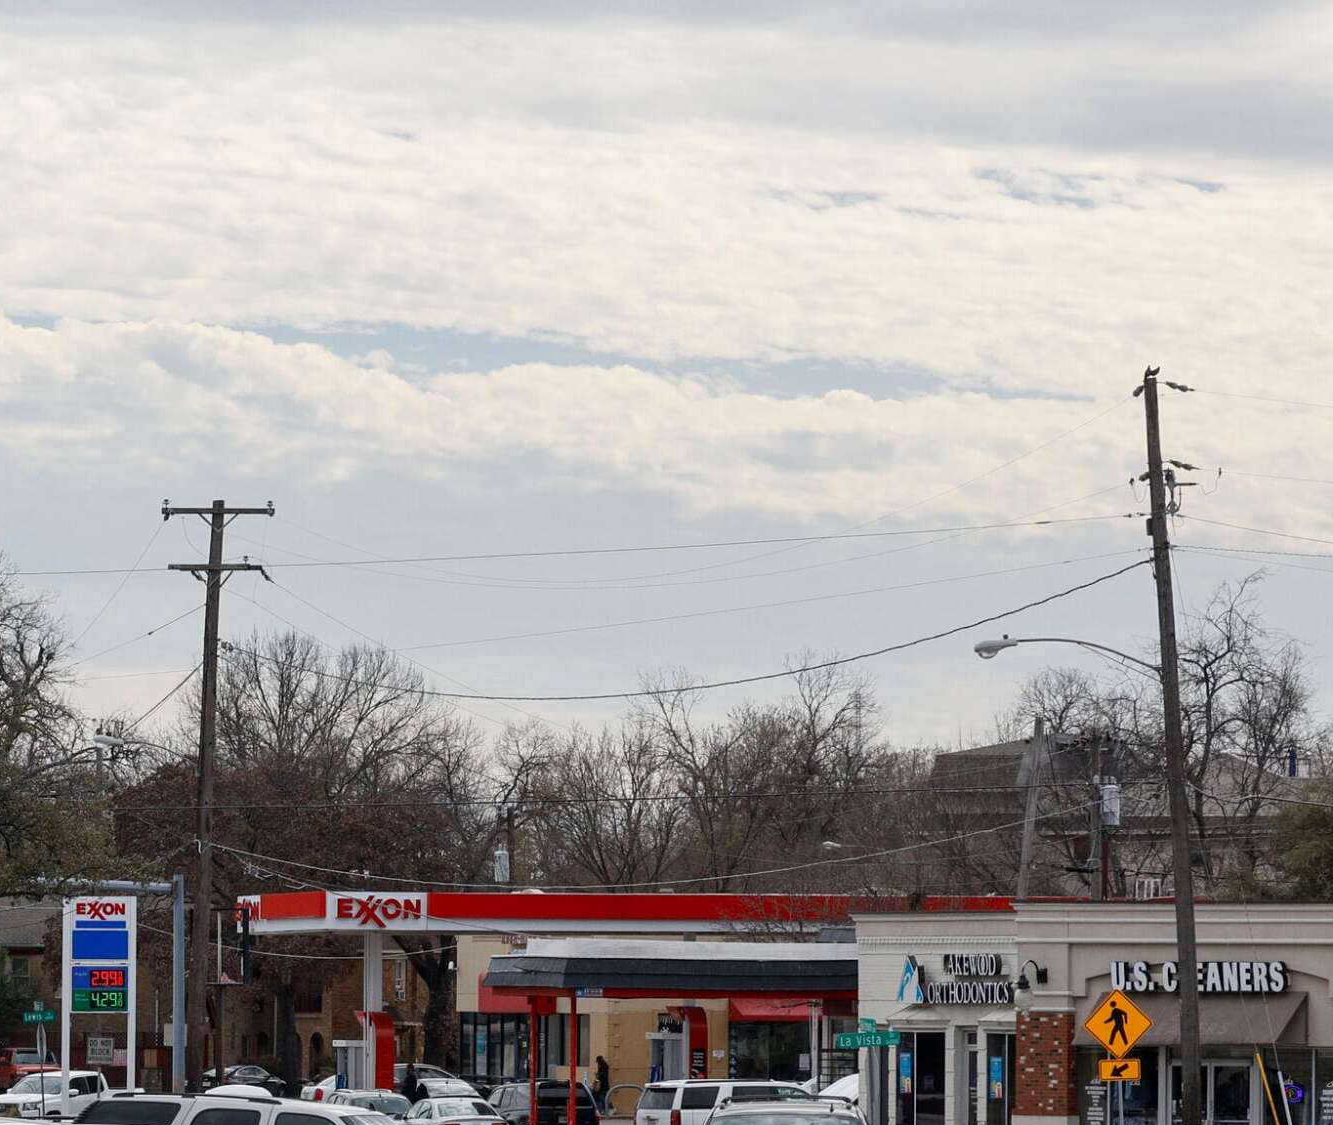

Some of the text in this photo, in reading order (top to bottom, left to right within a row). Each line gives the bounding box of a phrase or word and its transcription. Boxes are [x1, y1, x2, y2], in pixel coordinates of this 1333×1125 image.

[76, 901, 125, 920] EXXON
[337, 895, 422, 929] EXXON
[1110, 961, 1284, 992] U.S. CEANERS
[927, 981, 1010, 1004] ORTHODONTICS
[840, 1036, 852, 1047] La
[856, 1033, 882, 1046] Vista
